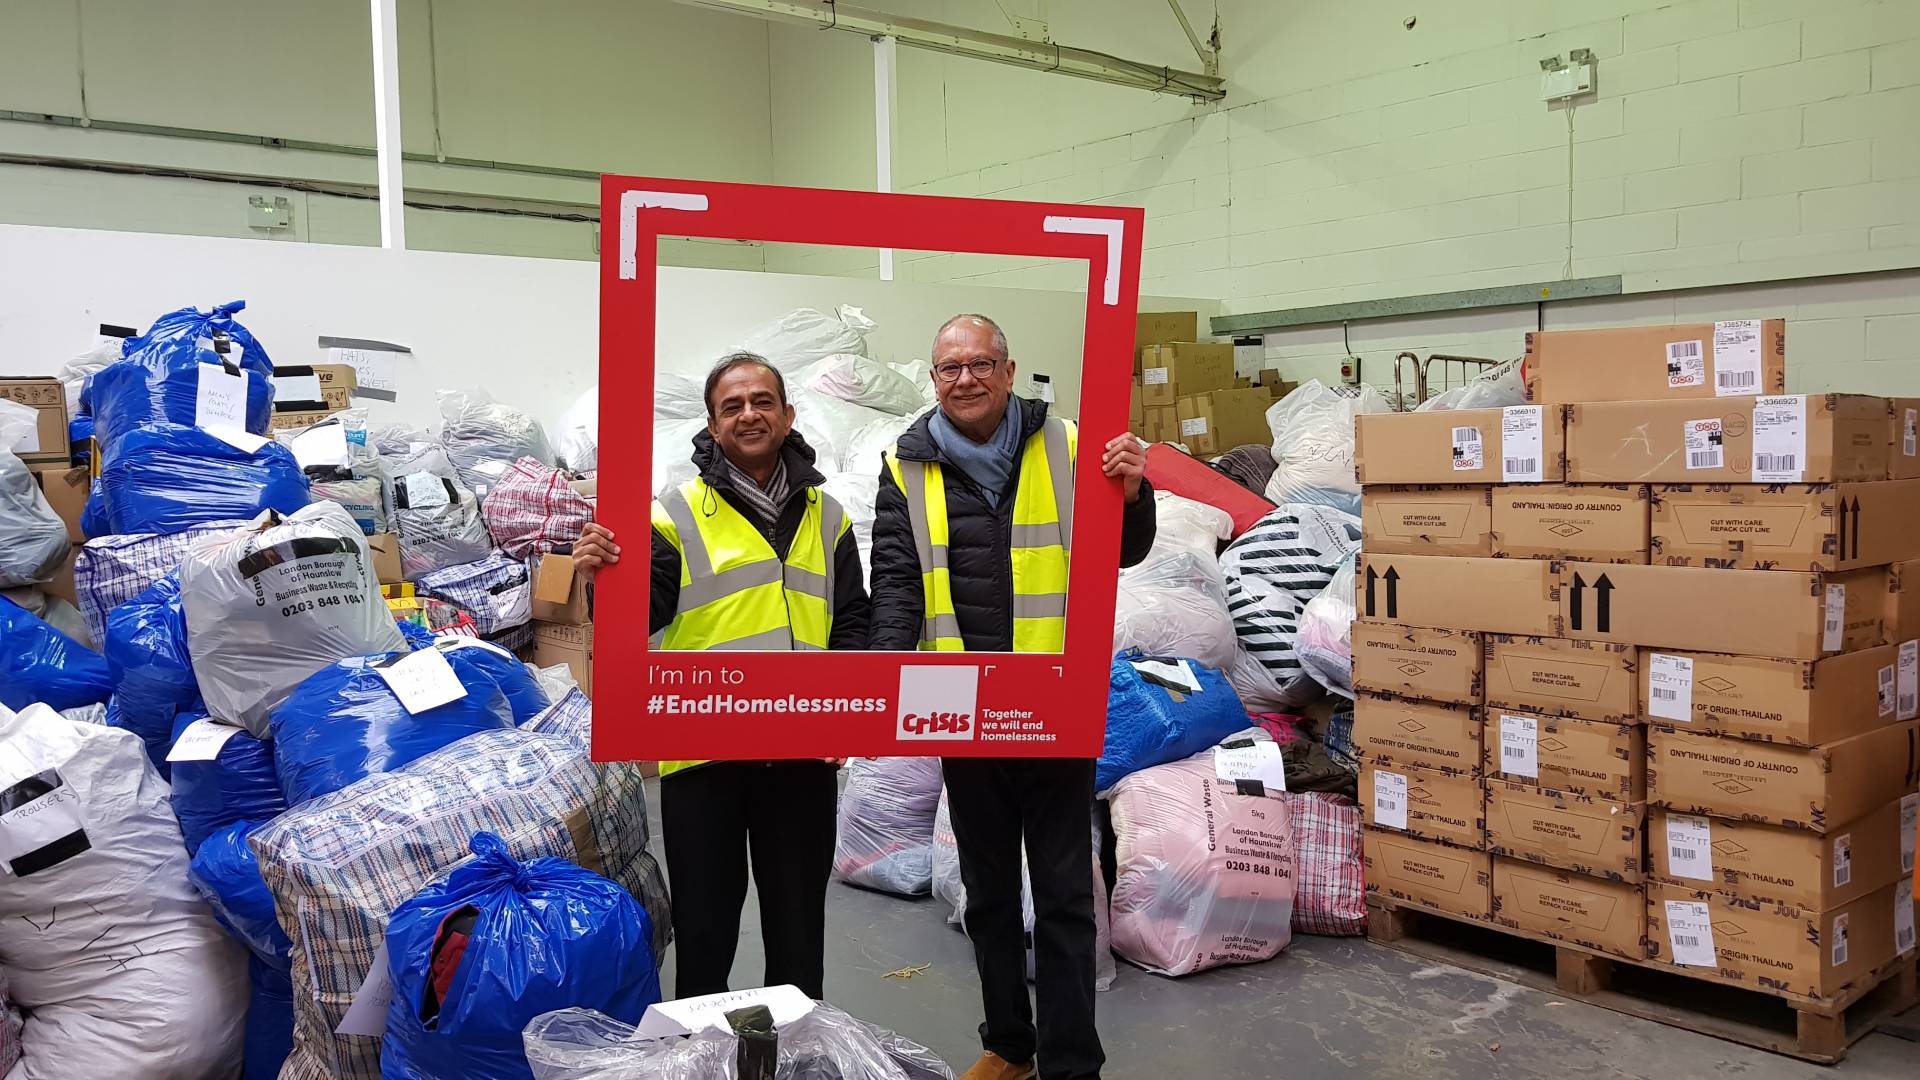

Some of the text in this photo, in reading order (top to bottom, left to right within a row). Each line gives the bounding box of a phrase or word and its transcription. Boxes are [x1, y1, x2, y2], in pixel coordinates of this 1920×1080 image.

[341, 504, 375, 512] CYCLING
[1574, 503, 1585, 511] OF
[1585, 503, 1622, 511] COUNTRY
[279, 560, 345, 576] London Borough
[290, 569, 342, 583] of Hounslow
[252, 574, 266, 607] Gene
[275, 580, 359, 602] Business Waste & Recycling
[282, 601, 315, 618] 0203
[318, 596, 341, 608] 848
[1427, 647, 1457, 657] COUNTRY
[692, 665, 713, 685] in
[720, 667, 744, 685] to
[646, 694, 887, 715] #EndHomelessness
[1697, 703, 1709, 712] OF
[982, 708, 1034, 721] Together
[981, 720, 1044, 730] we will end
[981, 731, 1057, 742] homelessness
[1369, 736, 1396, 747] COUNTRY
[1397, 741, 1406, 749] OF
[1743, 759, 1755, 768] OF
[1756, 761, 1799, 775] COUNTRY
[13, 789, 77, 819] TROUSERS
[1251, 809, 1265, 820] 5kg
[1205, 810, 1216, 851] General
[1232, 827, 1286, 843] London Borough
[1240, 836, 1282, 849] of Hounslow
[1225, 845, 1250, 857] Business
[1250, 848, 1266, 859] Waste
[1226, 860, 1292, 879] 0203 848 1041
